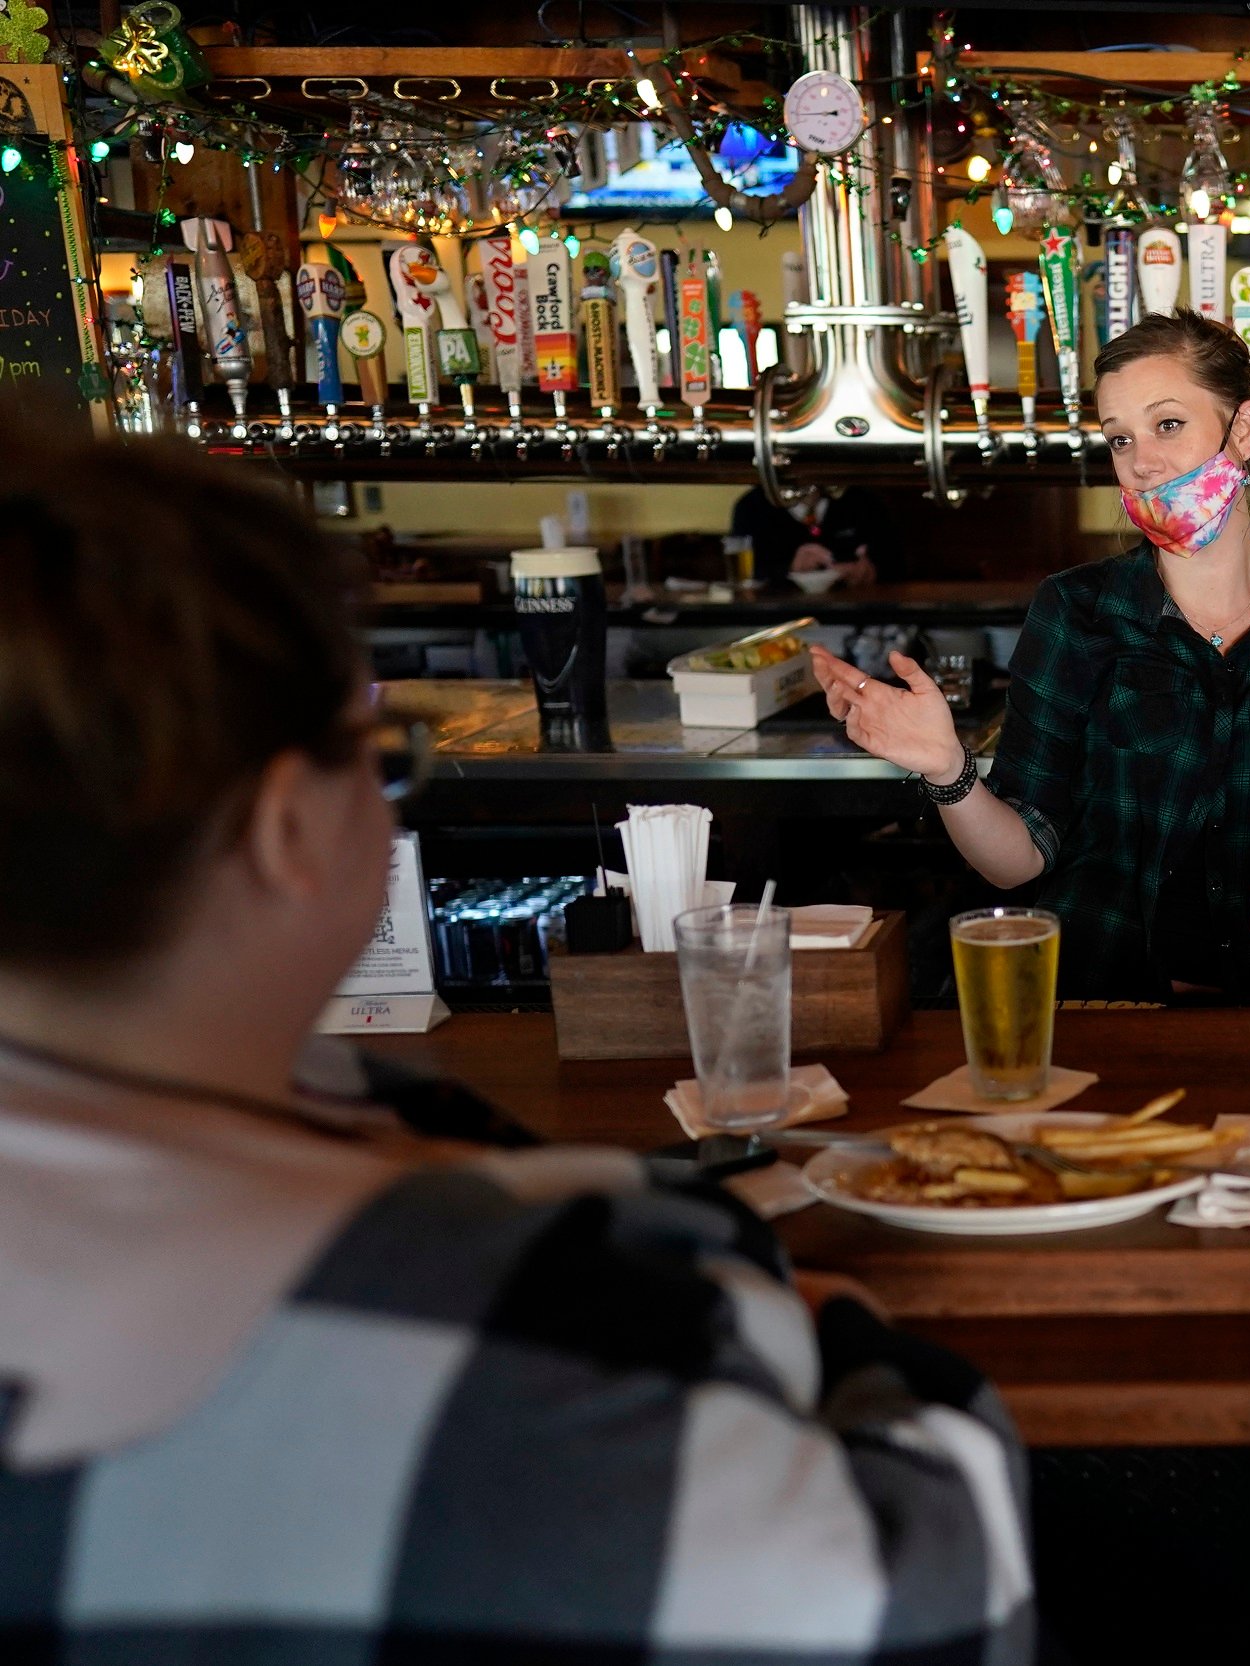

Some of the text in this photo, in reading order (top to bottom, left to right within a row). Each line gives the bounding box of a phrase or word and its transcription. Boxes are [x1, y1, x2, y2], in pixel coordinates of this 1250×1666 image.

[1201, 235, 1216, 299] ULTRA
[487, 239, 516, 346] Coors
[547, 263, 564, 330] Crawford
[1049, 262, 1071, 342] Heineken
[535, 295, 549, 331] Bock
[591, 302, 602, 339] GHOST
[0, 356, 41, 387] pm
[514, 596, 576, 613] GUINNESS
[351, 1007, 391, 1015] ULTRA
